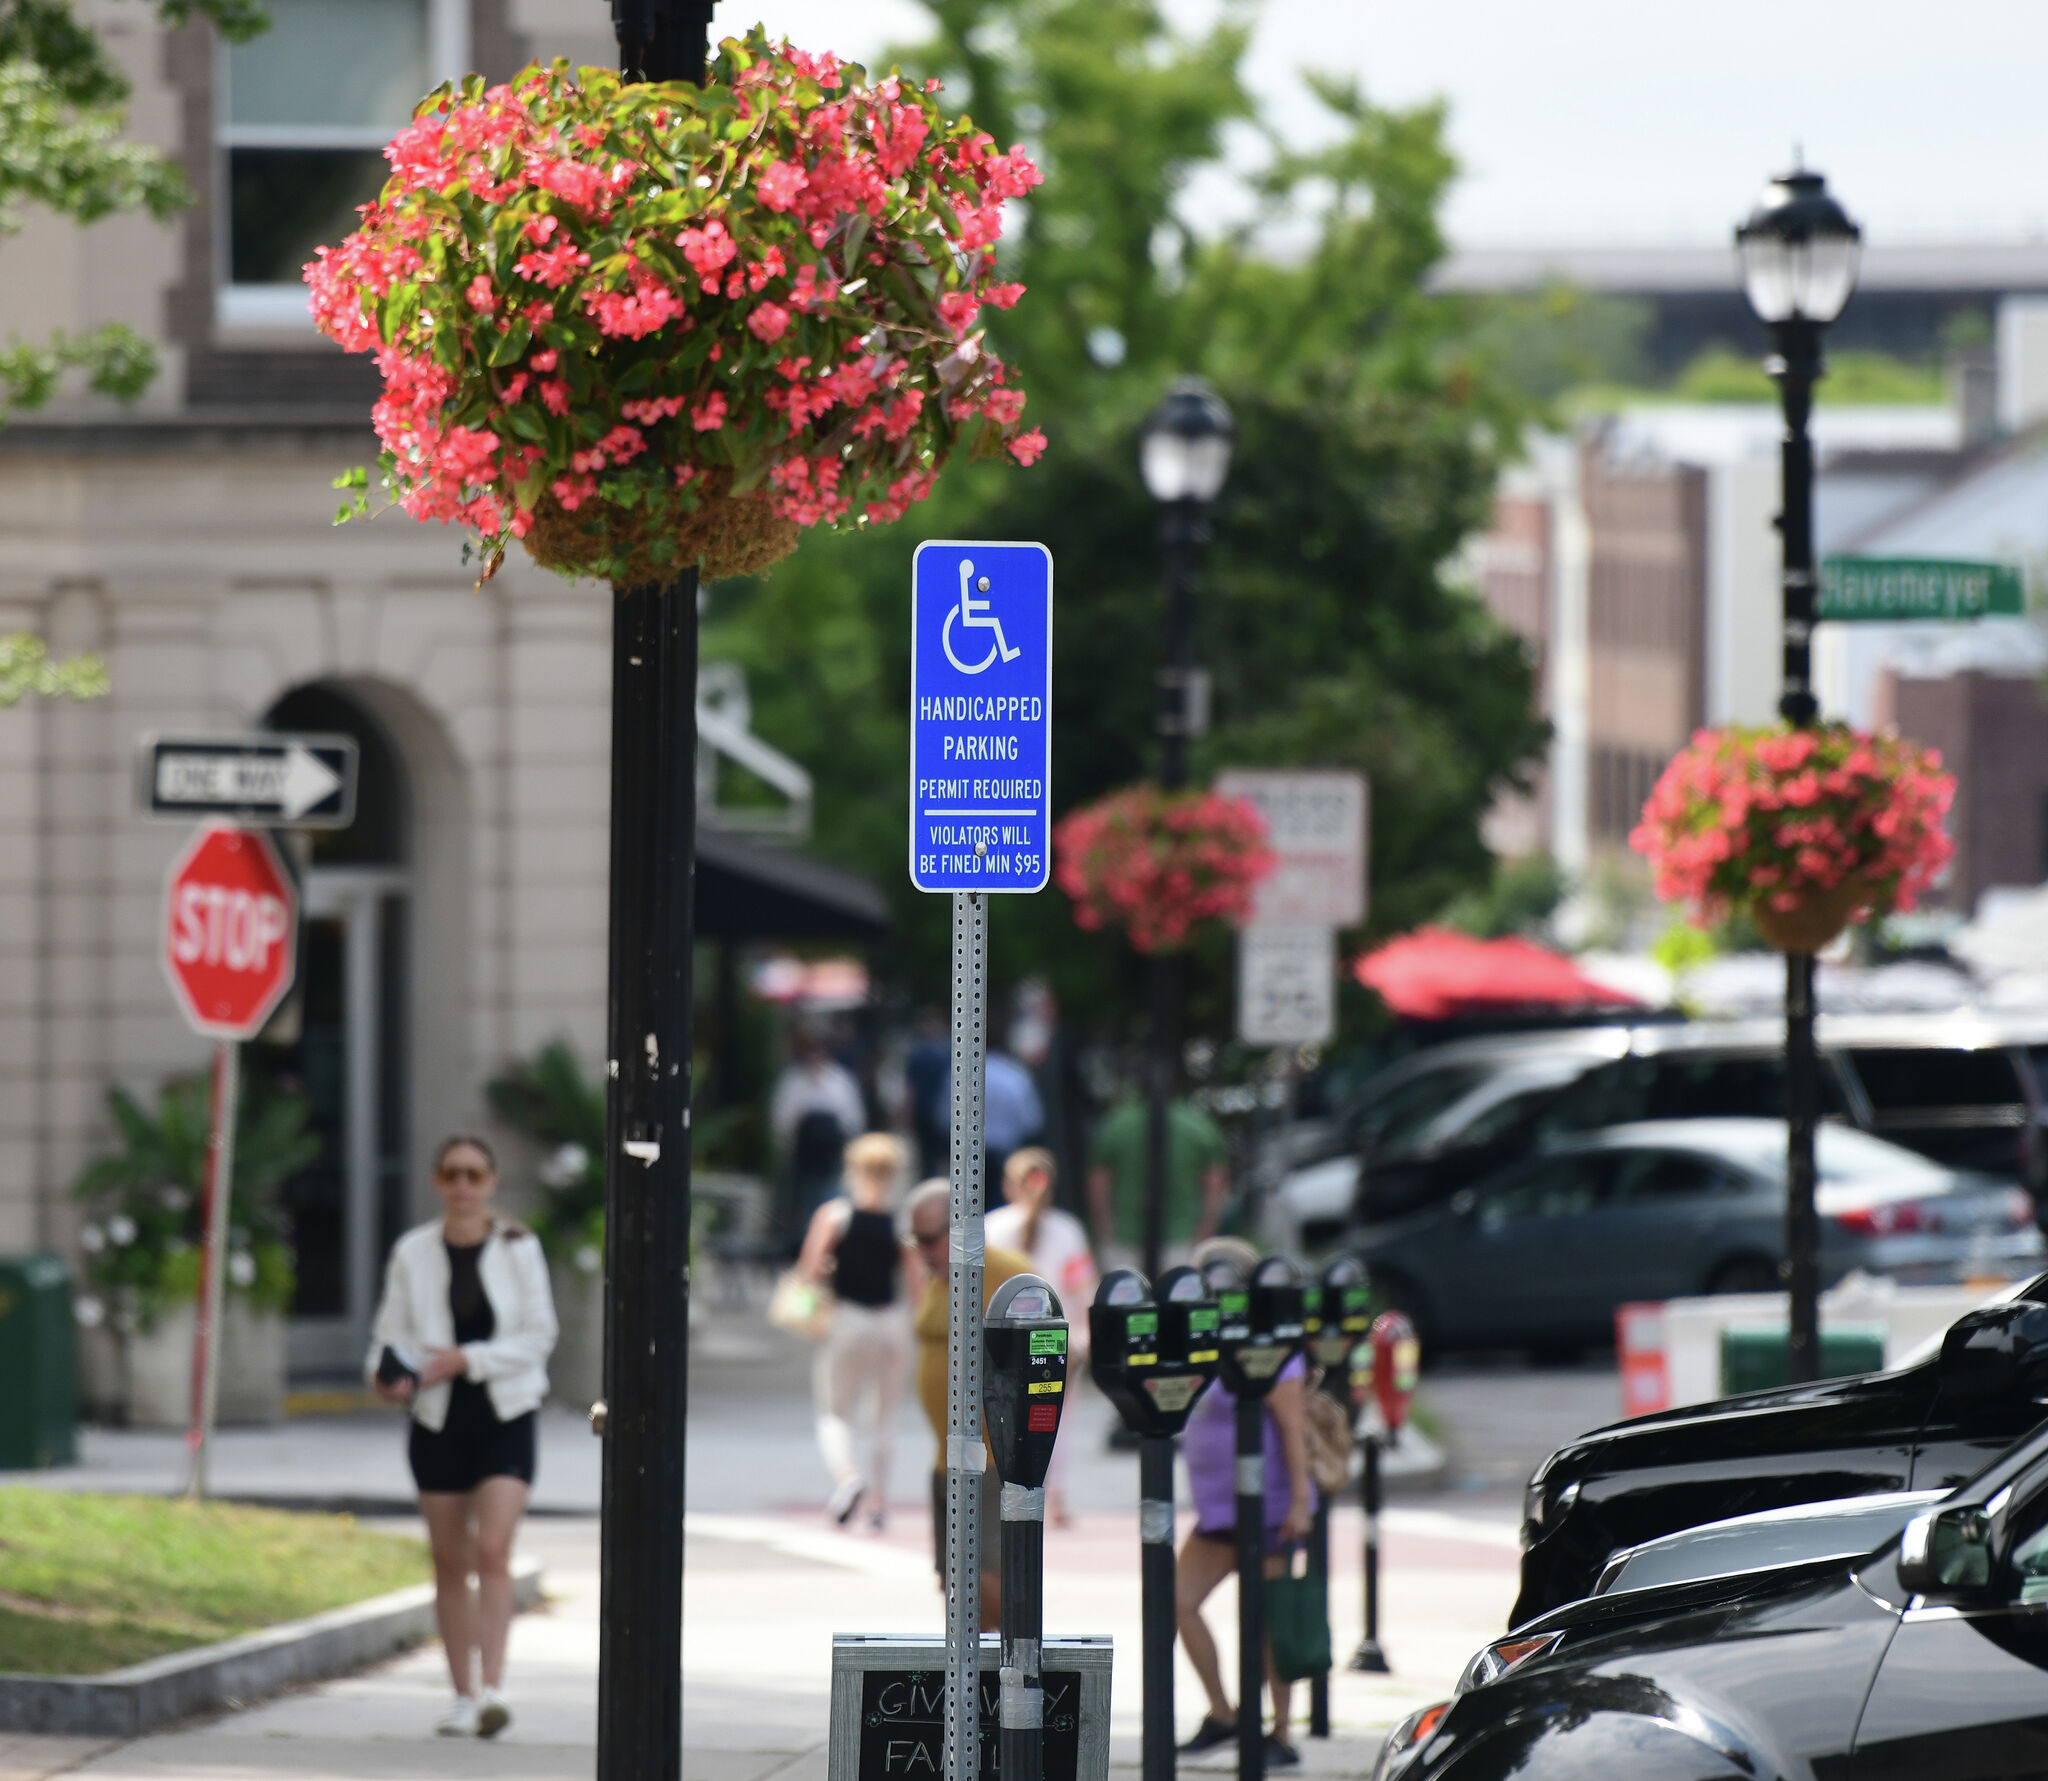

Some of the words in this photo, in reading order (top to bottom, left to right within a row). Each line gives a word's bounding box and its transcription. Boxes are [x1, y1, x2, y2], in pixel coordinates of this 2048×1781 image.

[920, 696, 1042, 722] HANDICAPPED
[943, 735, 1018, 761] PARKING
[919, 779, 970, 799] PERMIT
[973, 779, 1042, 800] REQUIRED
[930, 826, 999, 845] VIOLATORS
[1002, 826, 1031, 845] WILL
[920, 854, 937, 873] BE
[941, 854, 981, 873] FINED
[985, 854, 1010, 873] MIN
[1014, 852, 1040, 876] $95
[174, 883, 288, 973] STOP
[1031, 1357, 1047, 1365] 2451
[1038, 1383, 1052, 1393] 255
